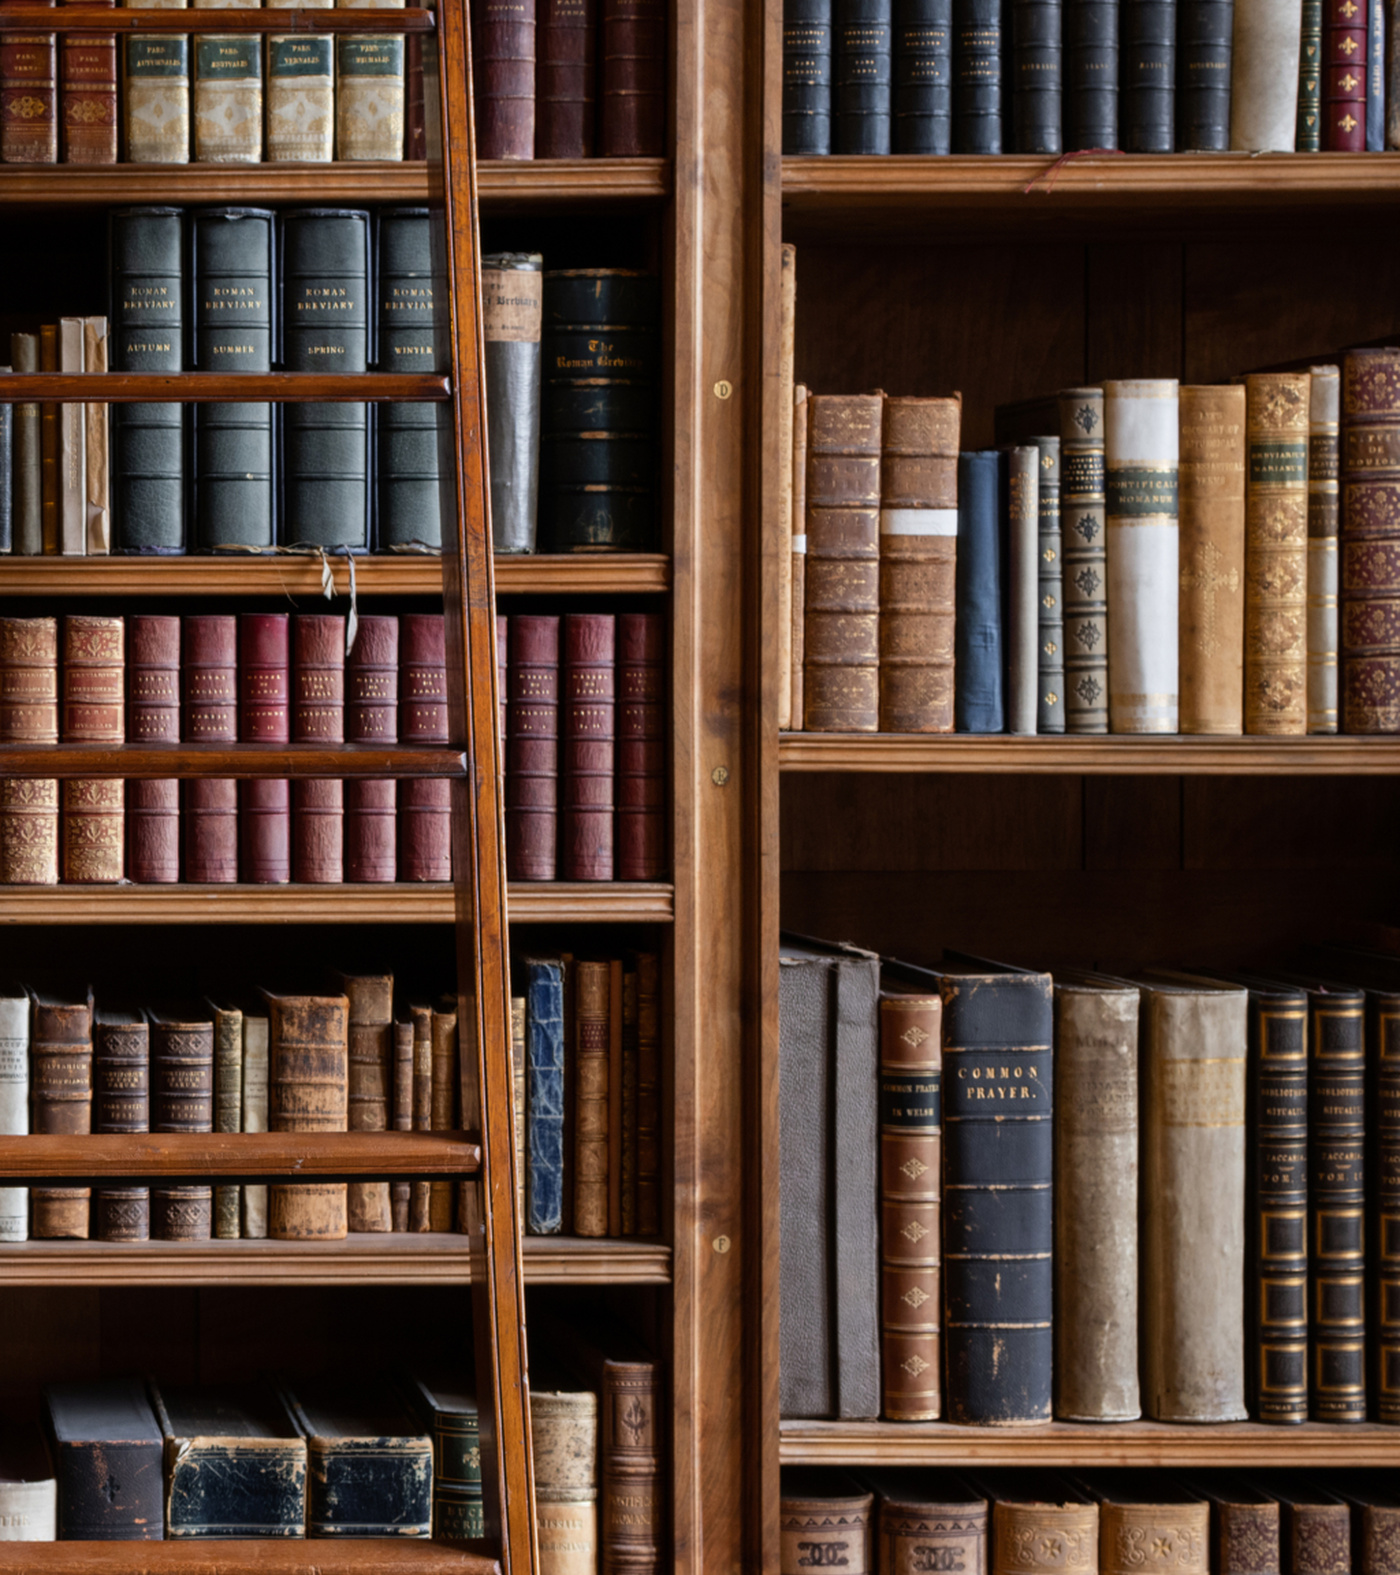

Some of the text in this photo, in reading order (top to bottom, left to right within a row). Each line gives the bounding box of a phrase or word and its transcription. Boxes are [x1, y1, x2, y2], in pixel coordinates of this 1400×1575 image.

[131, 287, 167, 296] ROMAN
[214, 287, 255, 296] ROMAN
[305, 288, 346, 296] ROMAN
[124, 301, 175, 309] BREVIARY
[205, 301, 262, 309] BREVIARY
[297, 301, 355, 310] BREVIARY
[385, 302, 433, 310] BREVIAR
[127, 344, 171, 352] AUTUMN
[213, 345, 255, 353] SUMMER
[308, 346, 345, 354] SPRING
[1368, 445, 1386, 455] DE
[1119, 495, 1173, 503] ROMANUM
[957, 1066, 1039, 1079] COMMON
[883, 1084, 913, 1093] COMMON
[966, 1086, 1038, 1100] PRAYER.
[906, 1108, 935, 1117] WELSH
